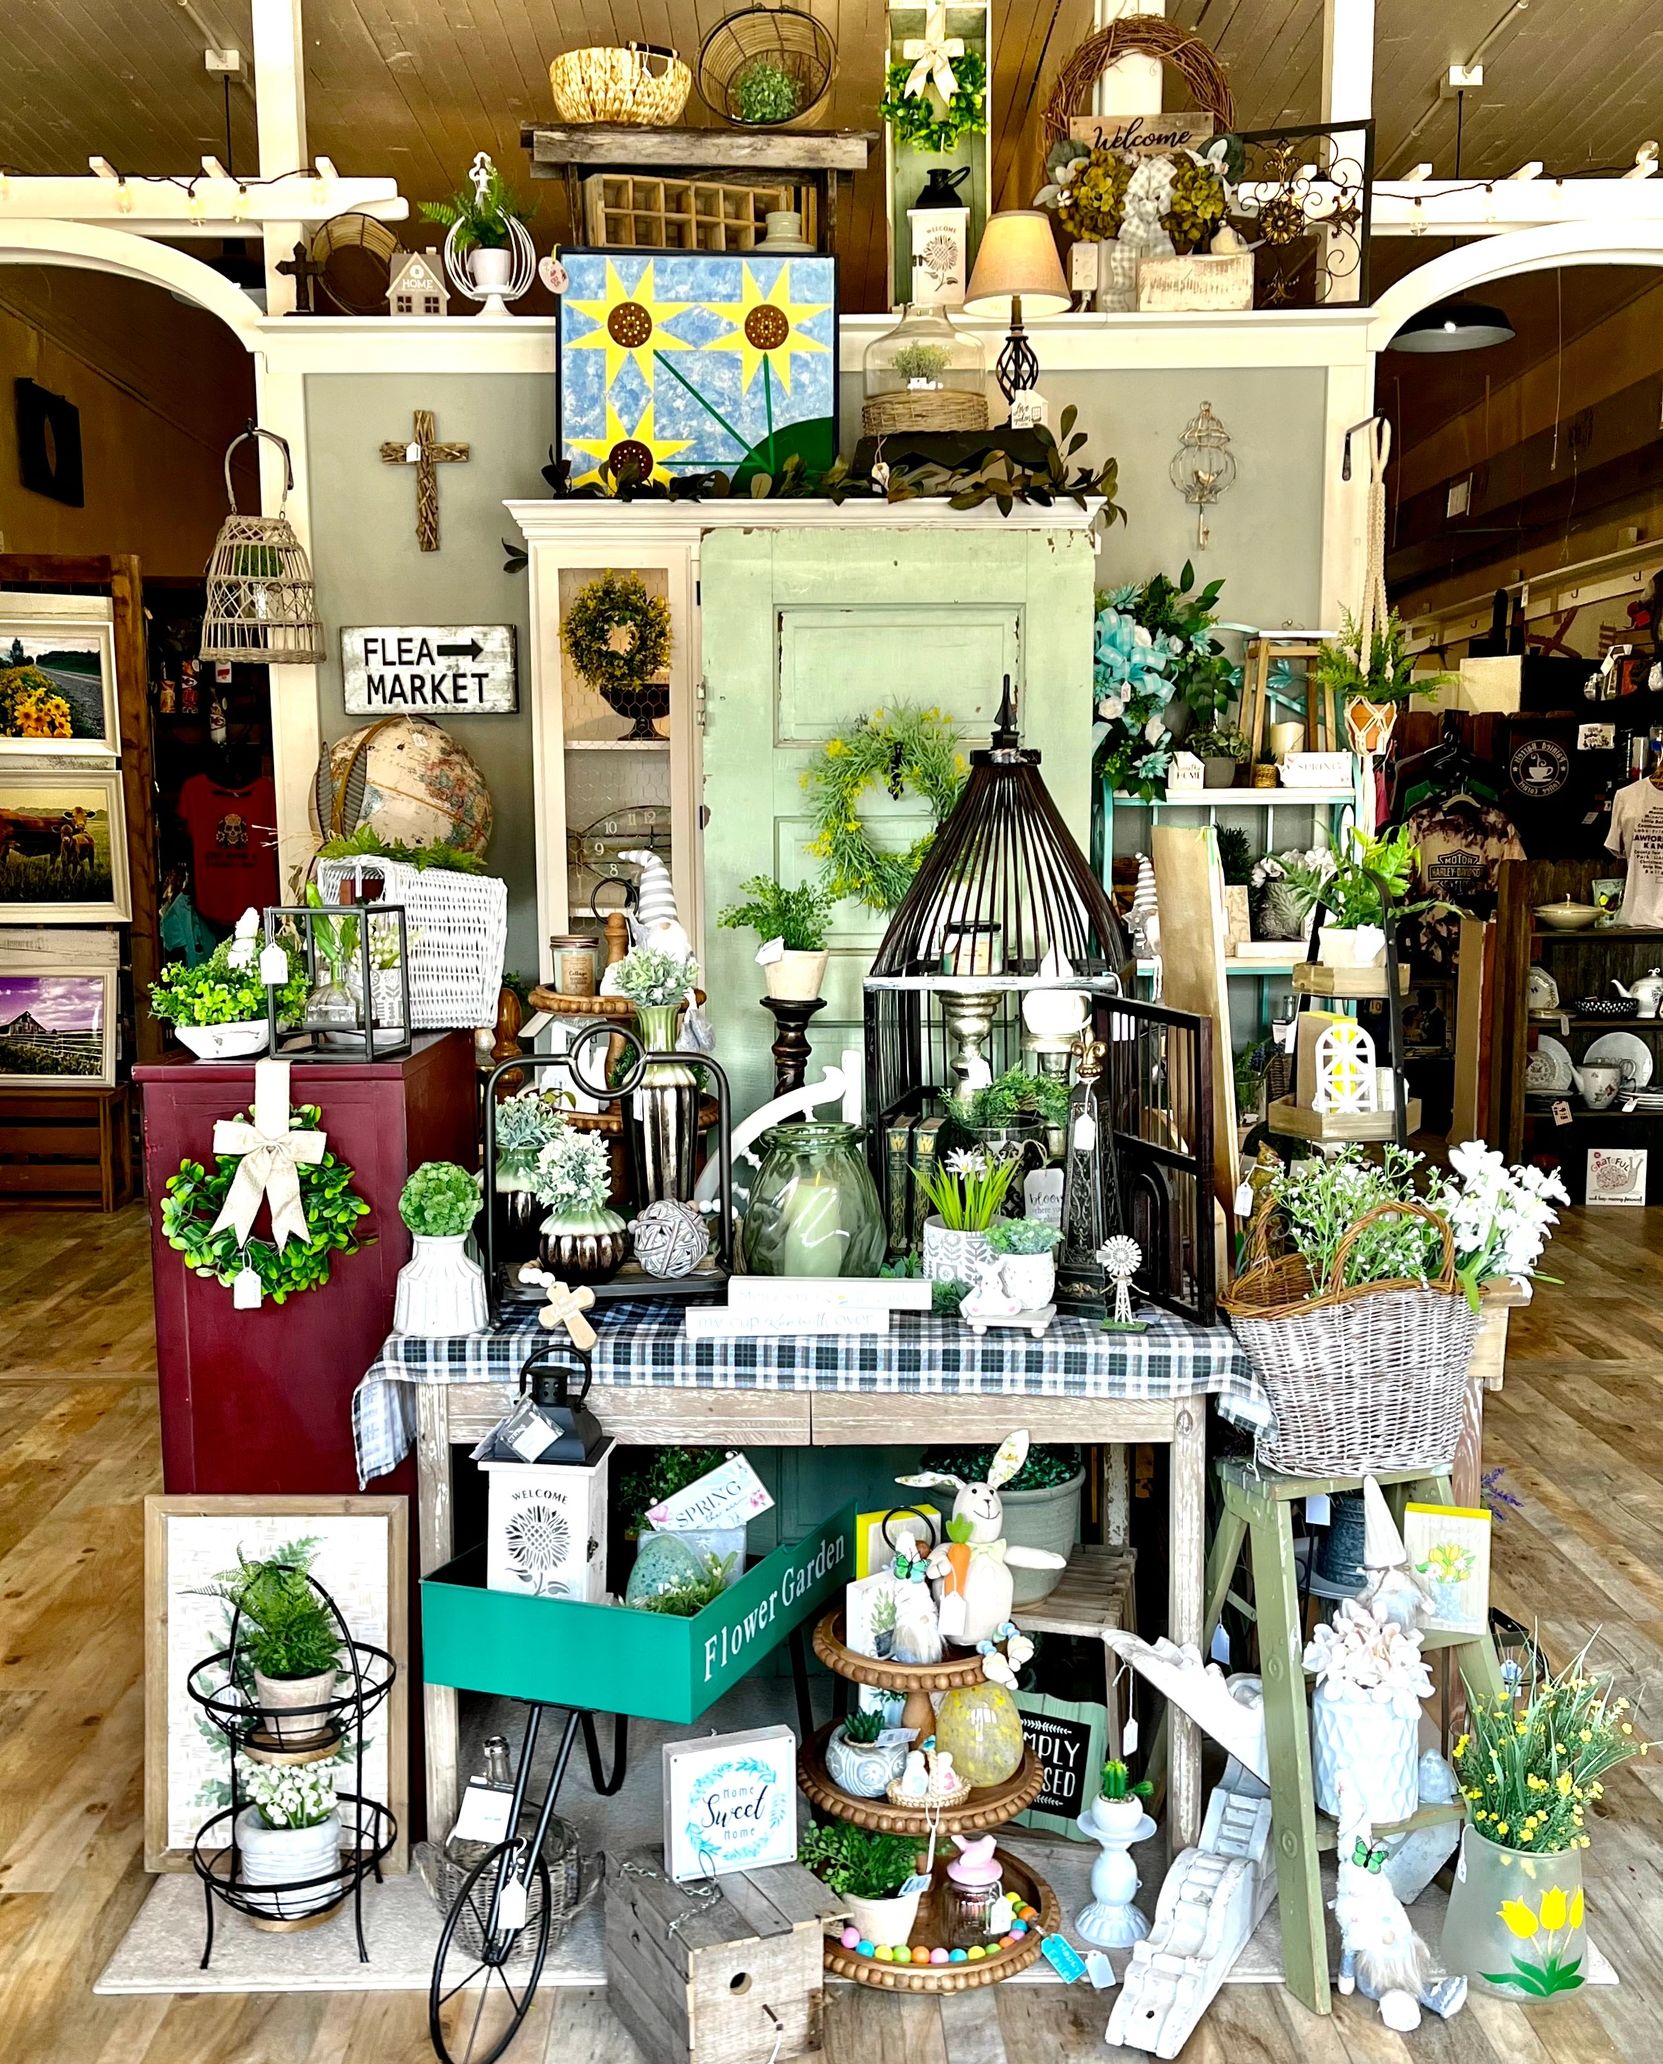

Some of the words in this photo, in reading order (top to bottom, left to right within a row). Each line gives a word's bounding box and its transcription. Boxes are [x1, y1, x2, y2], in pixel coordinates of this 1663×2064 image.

[1093, 116, 1193, 151] Welcome
[402, 279, 434, 289] HOME
[364, 637, 436, 666] FLEA
[367, 672, 489, 705] MARKET
[627, 814, 637, 826] 11
[644, 811, 656, 824] 12
[604, 821, 617, 834] 10
[594, 842, 605, 856] 9
[1444, 854, 1473, 865] MOTOR
[609, 863, 619, 877] 8
[1431, 867, 1482, 878] HARLEY-DAVIDSO
[511, 1488, 569, 1504] WELCOME
[675, 1480, 742, 1528] SPRING
[704, 1590, 778, 1683] Flower
[781, 1535, 846, 1607] Garden
[1023, 1731, 1081, 1768] MPLY
[1041, 1767, 1076, 1798] SED
[723, 1786, 754, 1799] Home
[701, 1784, 769, 1828] Sweet
[724, 1827, 755, 1841] Home
